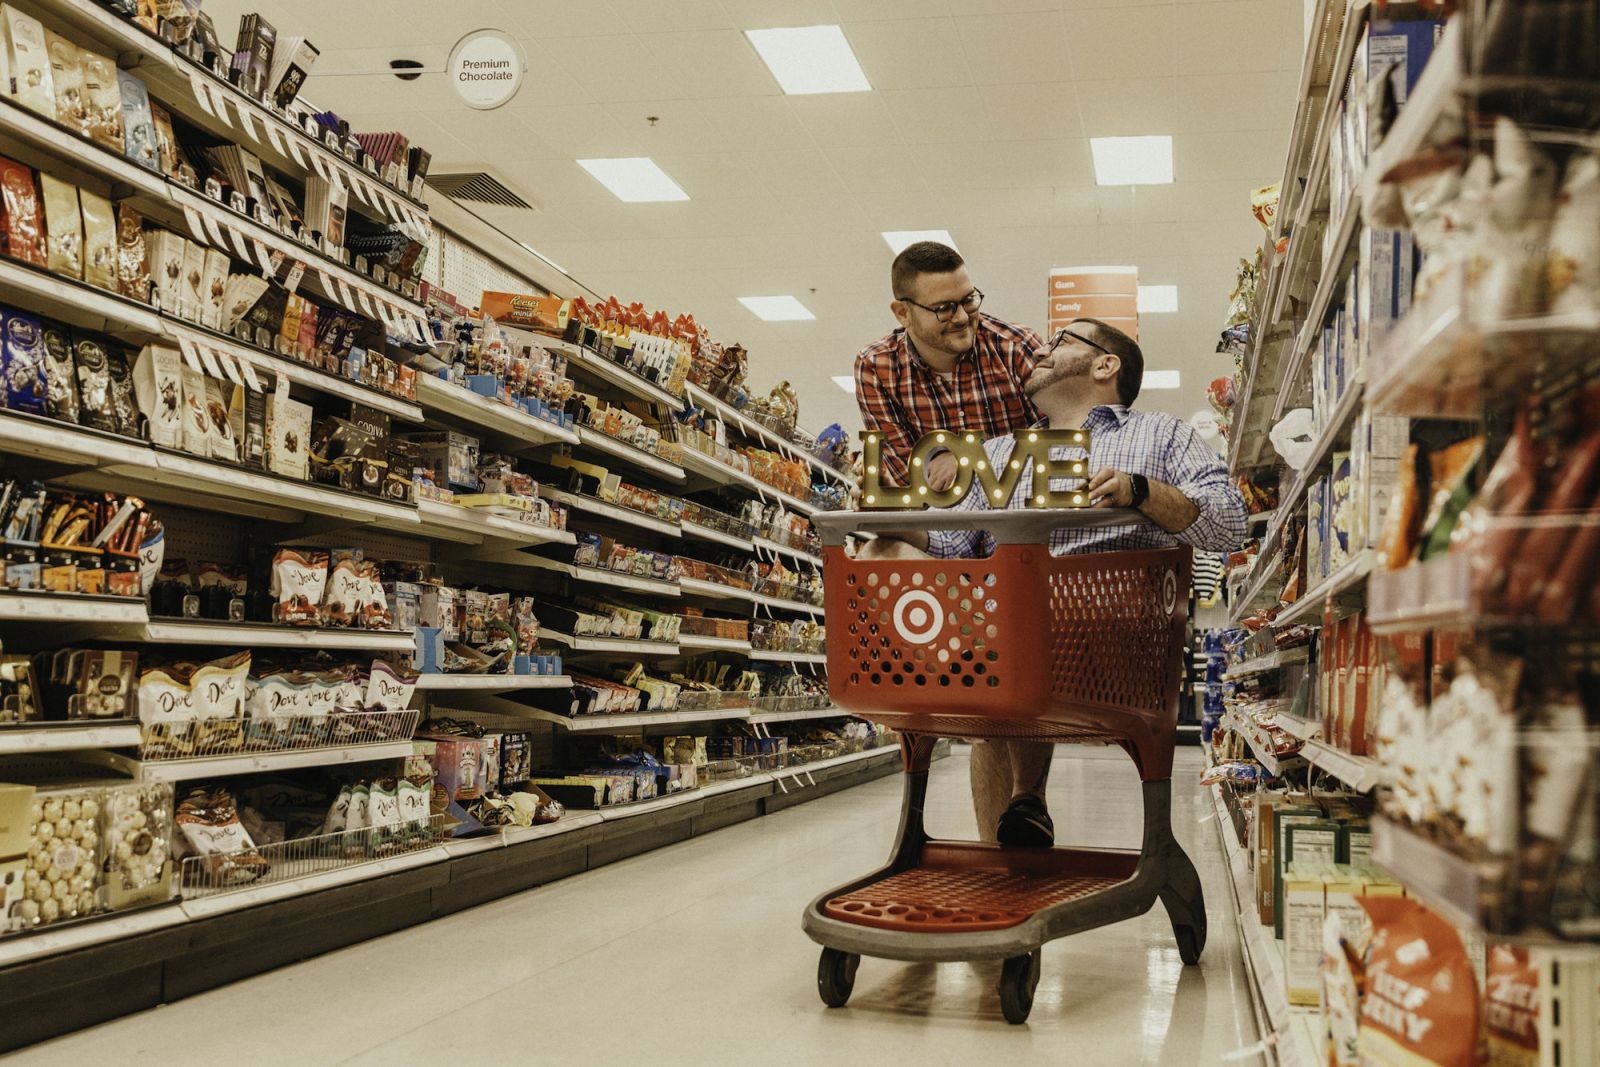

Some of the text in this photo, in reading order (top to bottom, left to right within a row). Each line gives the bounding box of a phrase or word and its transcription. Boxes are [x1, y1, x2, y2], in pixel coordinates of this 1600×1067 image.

[462, 58, 510, 69] Premium
[459, 71, 513, 82] Chocolate
[1055, 281, 1076, 289] Gum
[1055, 303, 1082, 312] Candy
[859, 429, 1092, 508] LOVE
[291, 568, 321, 586] Dove
[207, 676, 235, 704] Dove
[378, 679, 405, 697] Dove
[156, 690, 193, 713] Dove
[270, 690, 300, 712] Dove
[304, 688, 333, 707] Dove
[199, 827, 237, 843] Dove
